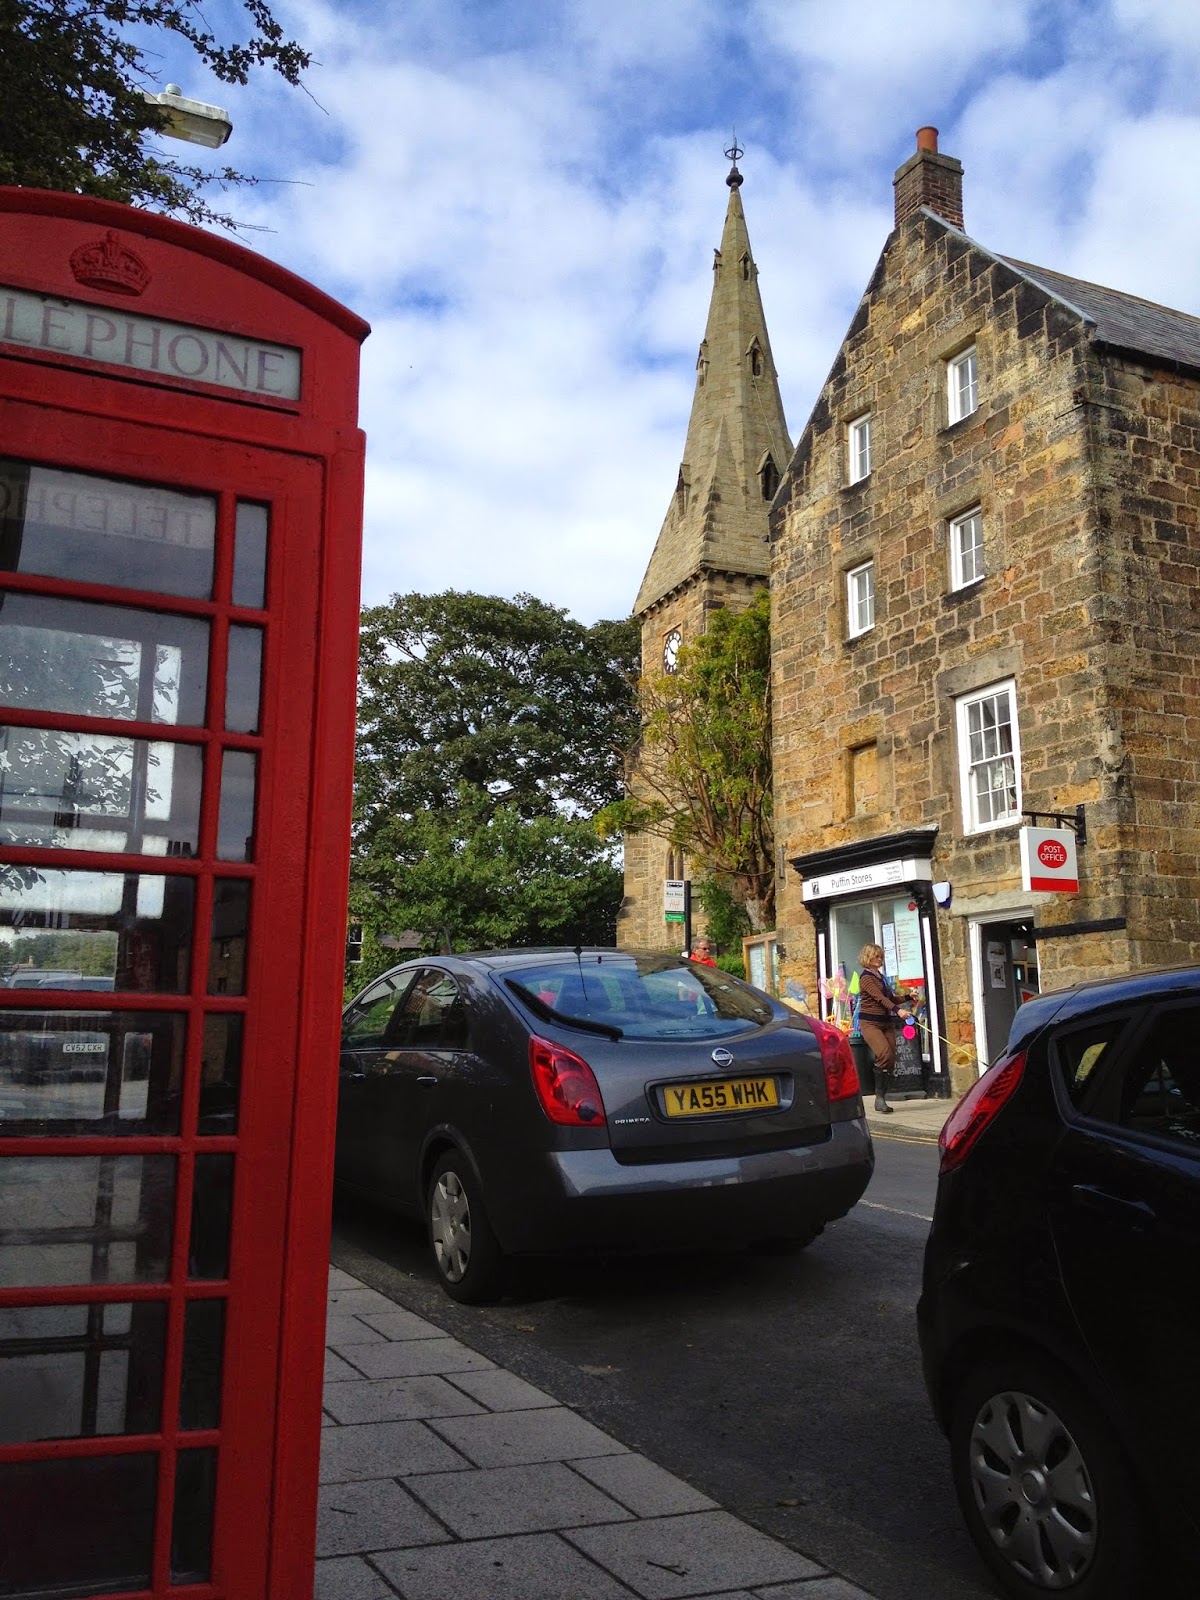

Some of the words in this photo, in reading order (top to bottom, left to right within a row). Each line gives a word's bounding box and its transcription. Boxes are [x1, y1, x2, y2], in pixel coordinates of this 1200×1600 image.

[1043, 845, 1061, 853] POST
[1040, 853, 1064, 862] OFFICE
[831, 876, 851, 889] Puffin
[851, 873, 872, 885] Stores
[673, 1086, 727, 1111] YA55
[731, 1081, 769, 1105] WHK
[614, 1117, 650, 1125] PRIMERA
